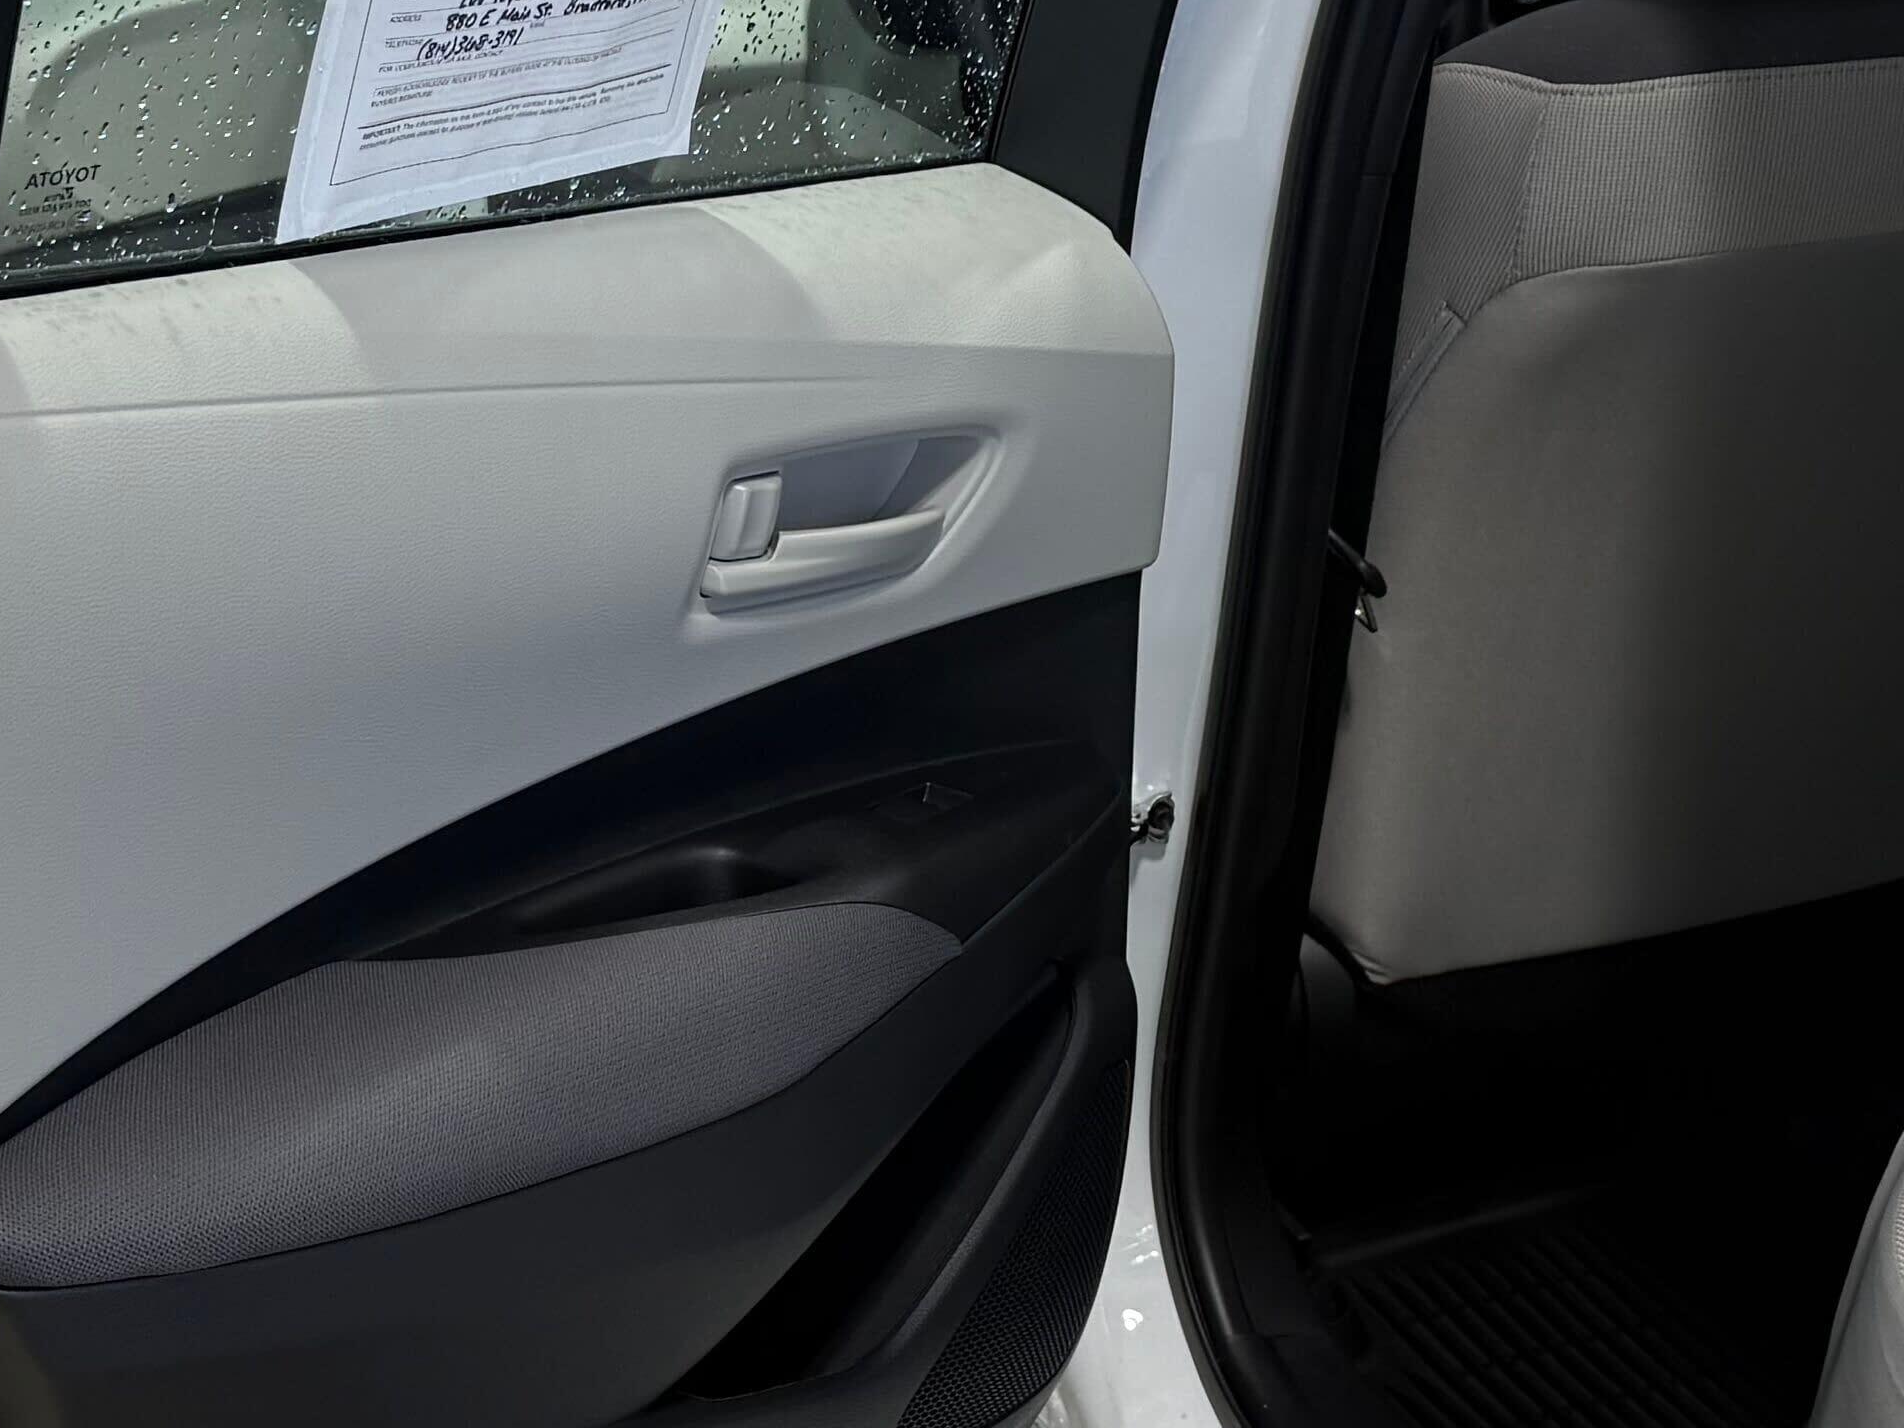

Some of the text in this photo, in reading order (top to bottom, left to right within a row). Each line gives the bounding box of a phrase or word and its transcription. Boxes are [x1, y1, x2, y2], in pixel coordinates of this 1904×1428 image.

[446, 13, 477, 31] 880
[479, 8, 497, 27] E
[497, 6, 531, 25] Main
